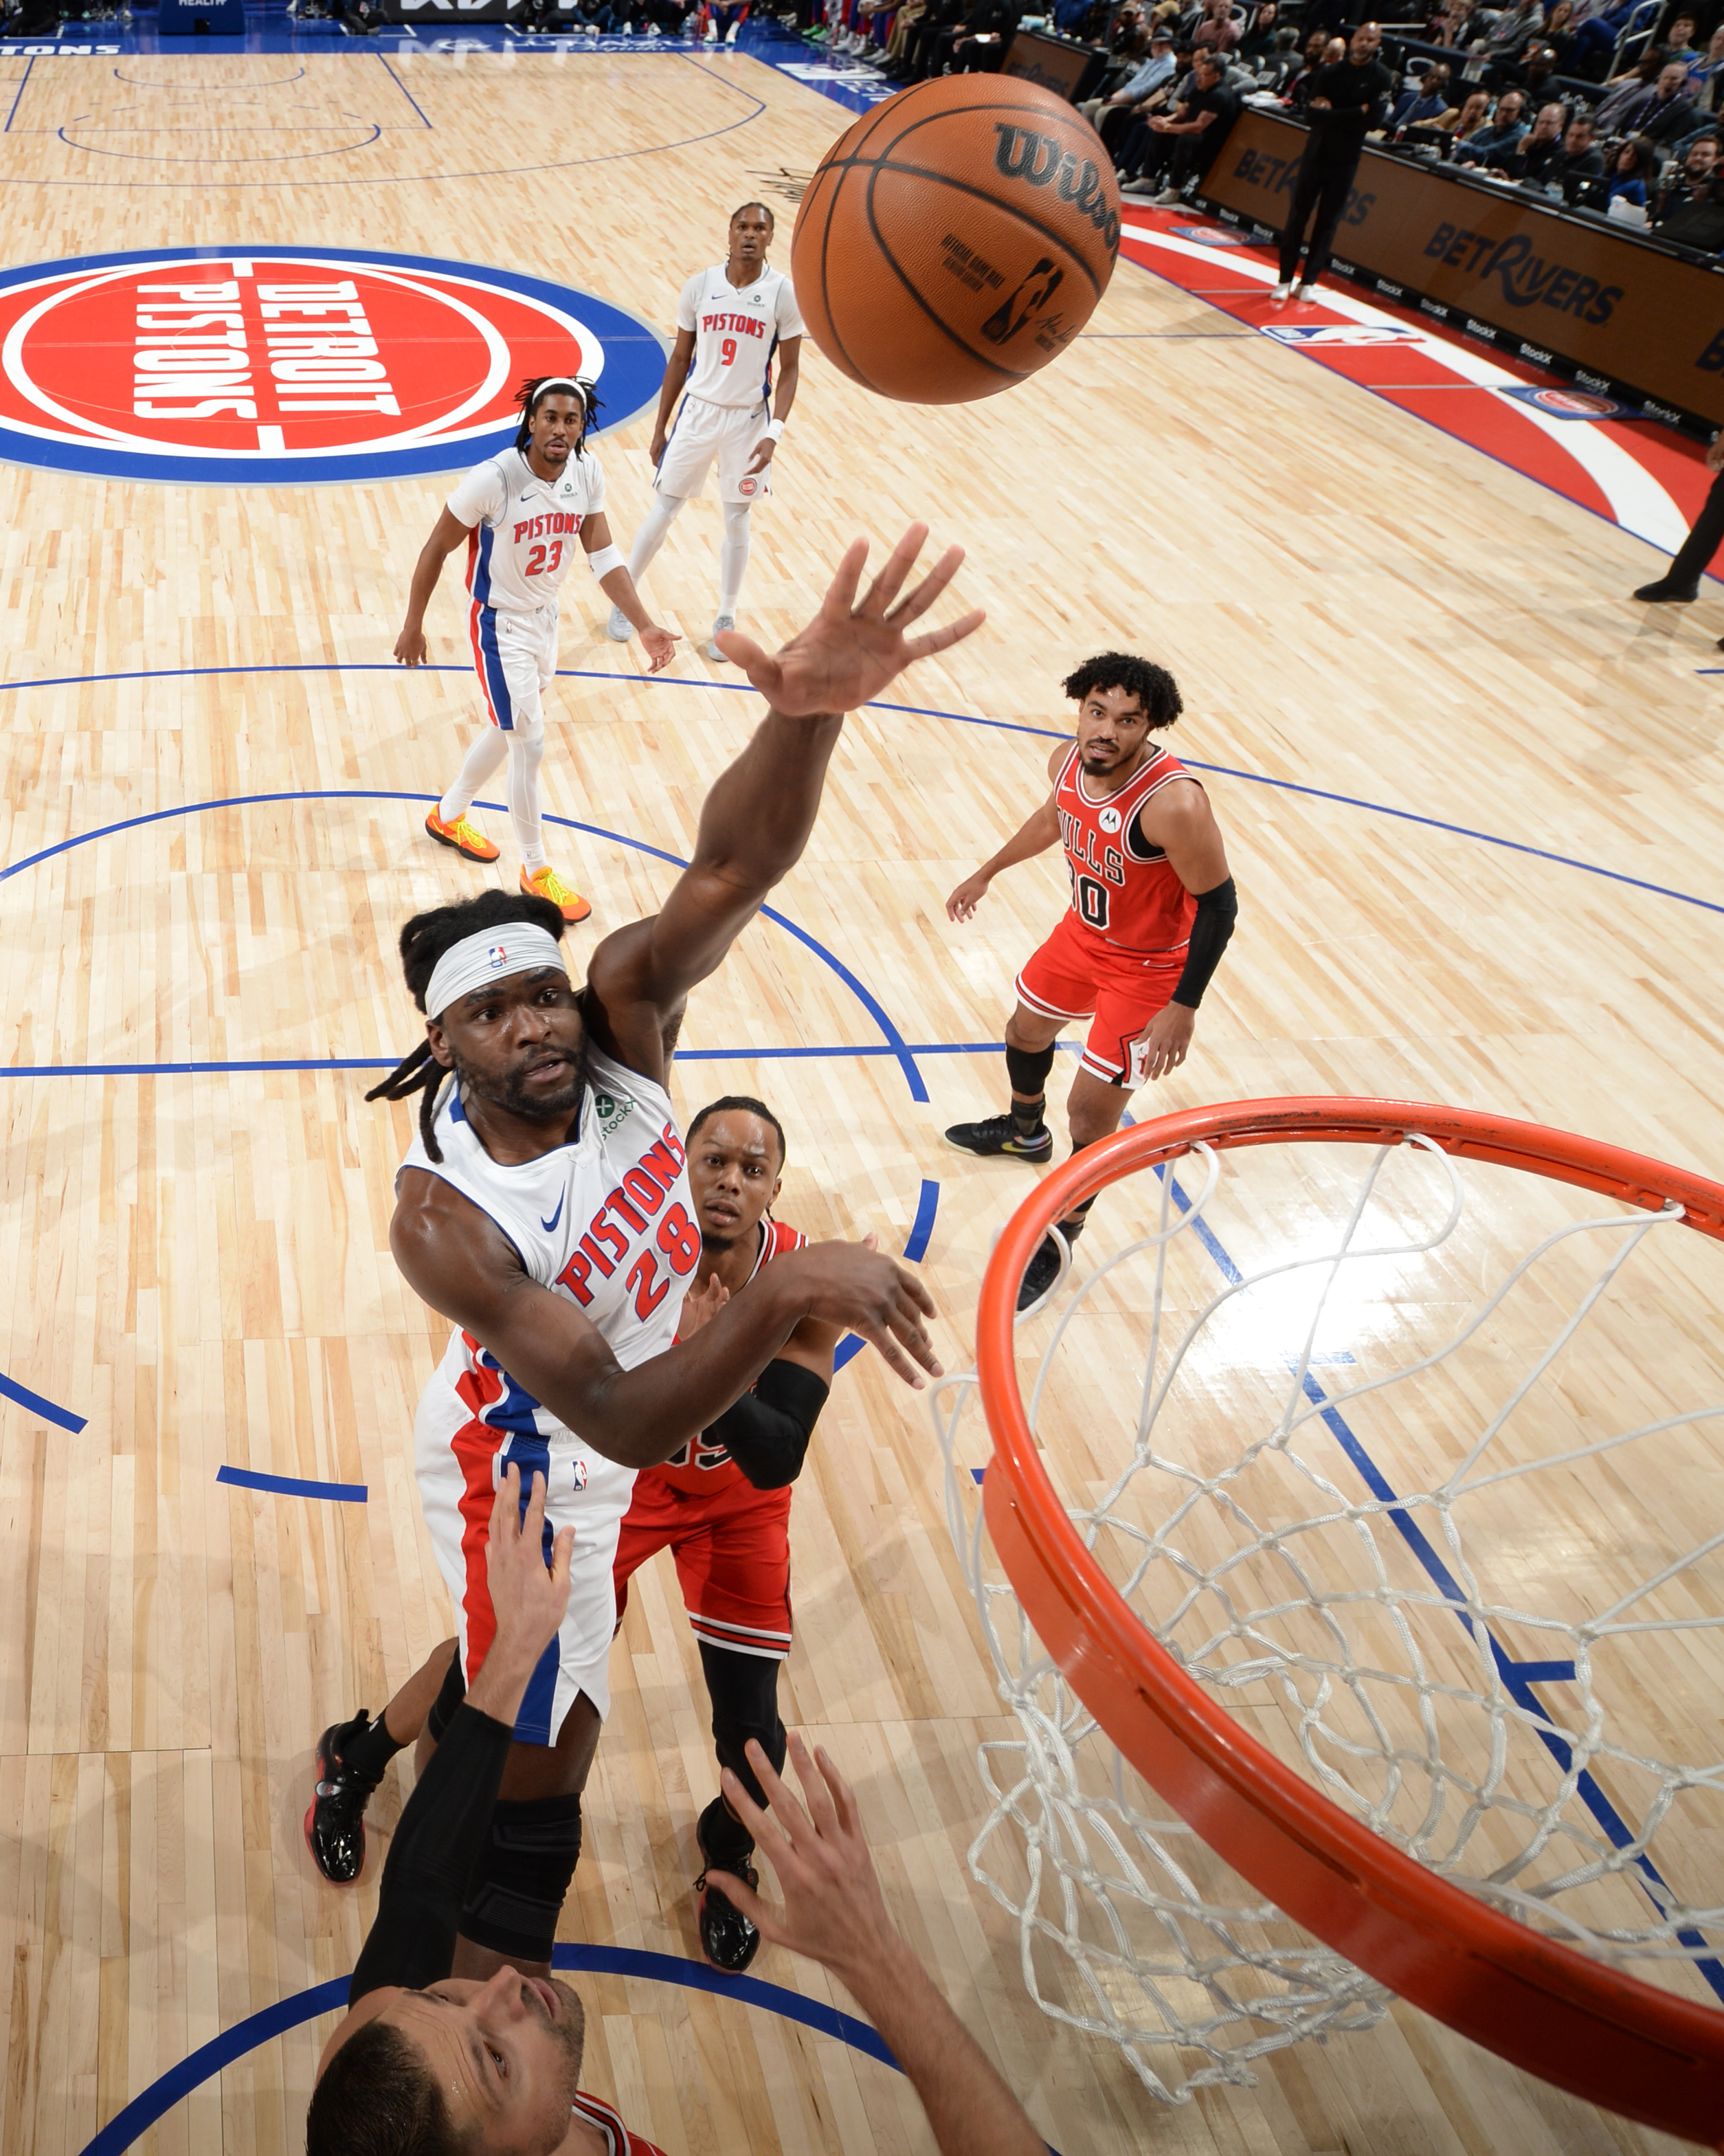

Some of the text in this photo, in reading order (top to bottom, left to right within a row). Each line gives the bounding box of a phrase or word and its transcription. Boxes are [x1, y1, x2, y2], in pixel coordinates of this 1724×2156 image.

[0, 45, 121, 55] TONS
[994, 122, 1120, 265] Wilso
[1234, 148, 1376, 226] BETRS
[1376, 279, 1403, 296] StockX
[1420, 298, 1448, 318] StockX
[702, 313, 766, 340] PISTONS
[1466, 319, 1497, 340] StockX
[133, 280, 258, 419] PISTONS
[256, 280, 401, 416] DETROIT
[721, 338, 737, 366] 9
[1520, 343, 1552, 364] StockX
[1575, 370, 1611, 392] StockX
[1643, 401, 1681, 425] StockX
[513, 512, 583, 544] PISTONS
[525, 540, 563, 577] 23
[555, 1122, 686, 1308] PISTONS
[625, 1201, 701, 1323] 28
